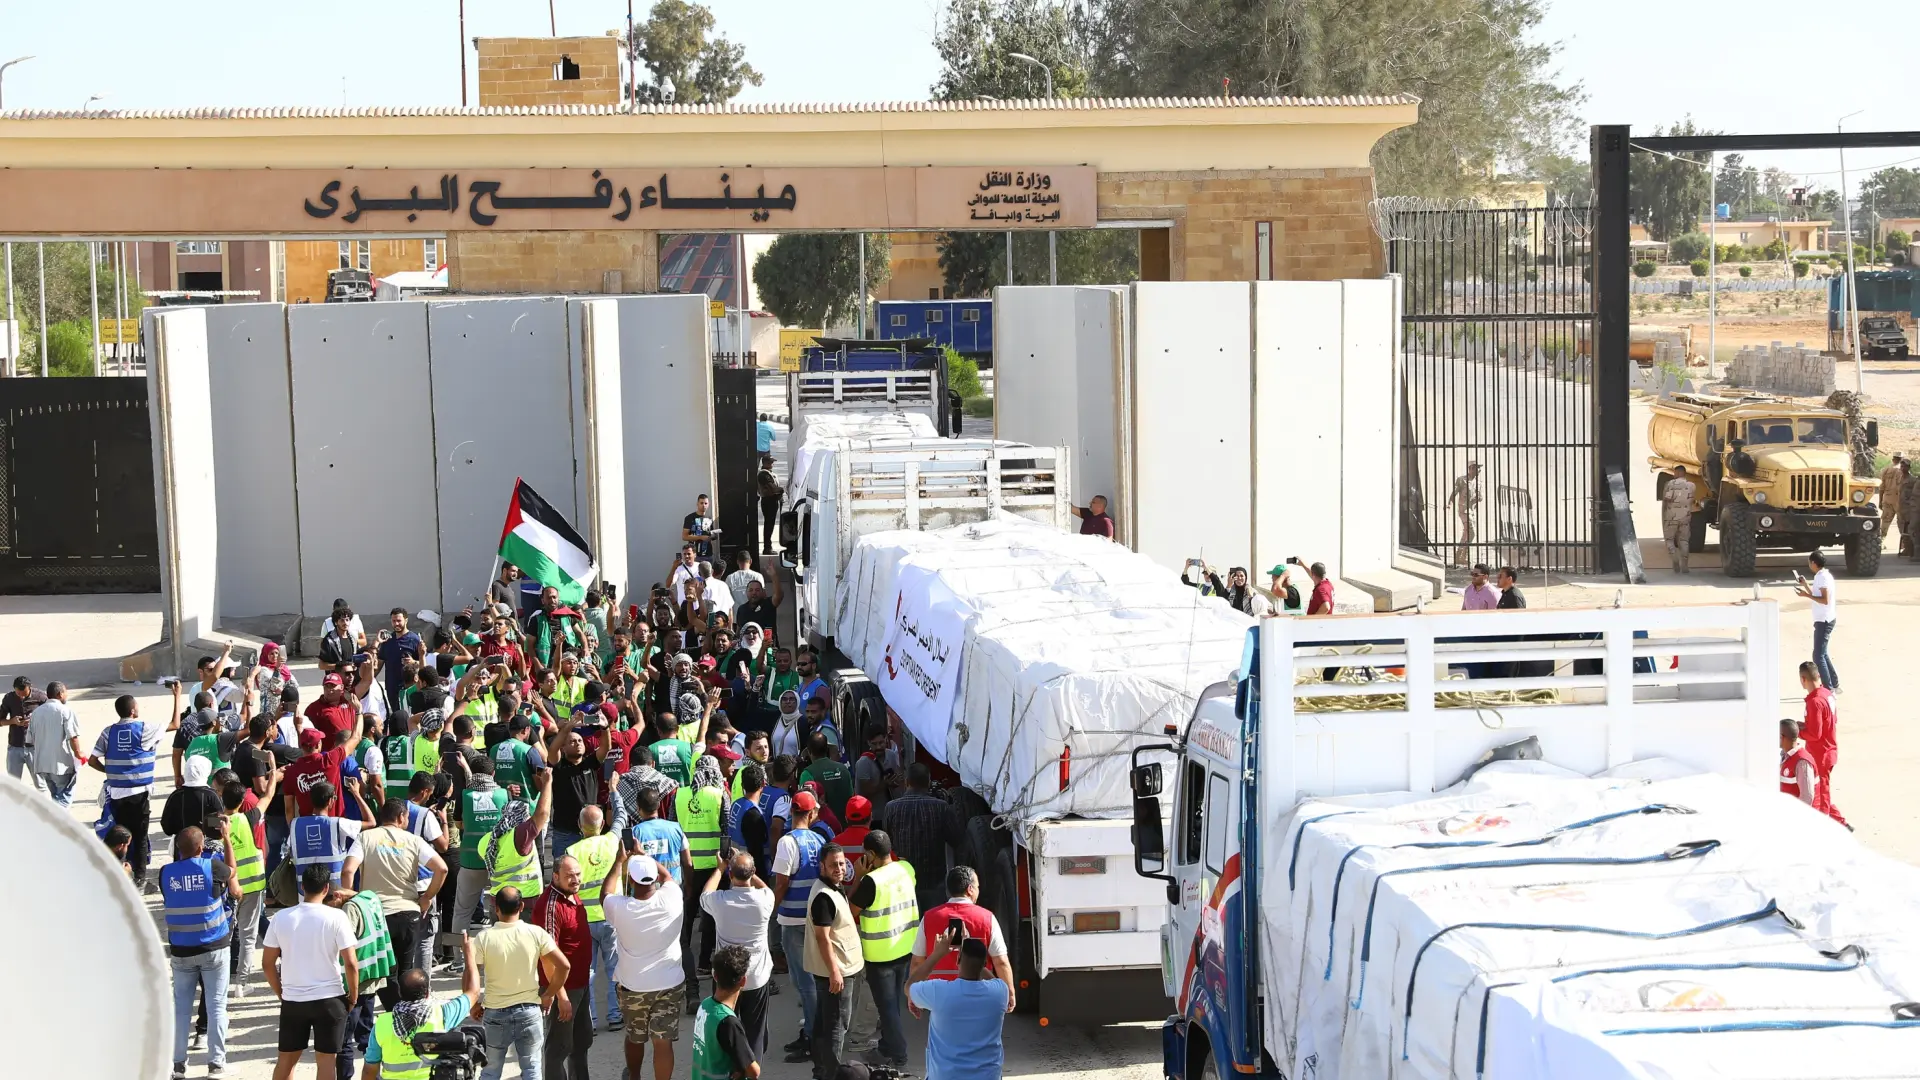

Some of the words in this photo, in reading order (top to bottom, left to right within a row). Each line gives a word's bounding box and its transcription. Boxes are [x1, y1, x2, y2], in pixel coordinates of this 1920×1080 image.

[979, 171, 1012, 190] النقل
[1016, 171, 1051, 190] وزارة
[468, 169, 632, 226] رفح
[640, 171, 797, 221] ميناء
[1001, 193, 1030, 203] العامة
